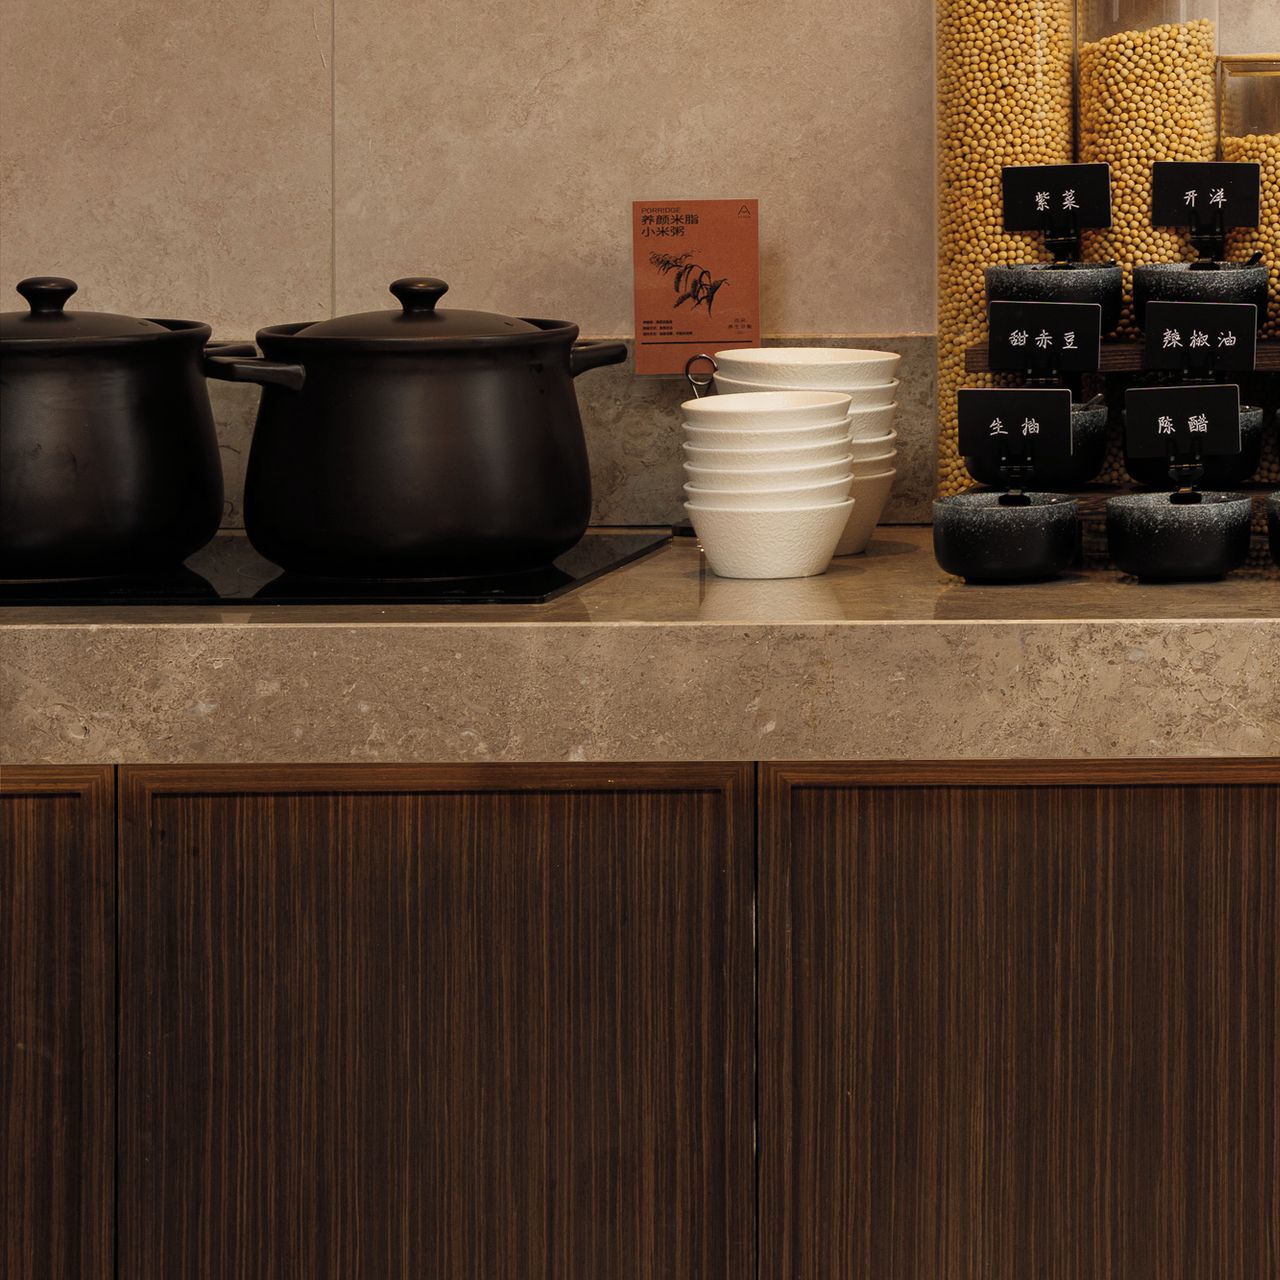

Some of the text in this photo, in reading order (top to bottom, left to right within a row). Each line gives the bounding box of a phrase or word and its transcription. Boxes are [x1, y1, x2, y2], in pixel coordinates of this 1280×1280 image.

[1035, 189, 1080, 212] 紫菜
[1183, 187, 1228, 209] 开洋
[641, 226, 685, 237] 小米粥
[1008, 329, 1079, 350] 甜赤豆
[1162, 328, 1237, 349] 辣椒油
[989, 417, 1040, 436] 生抽
[1157, 413, 1209, 435] 陈醋
